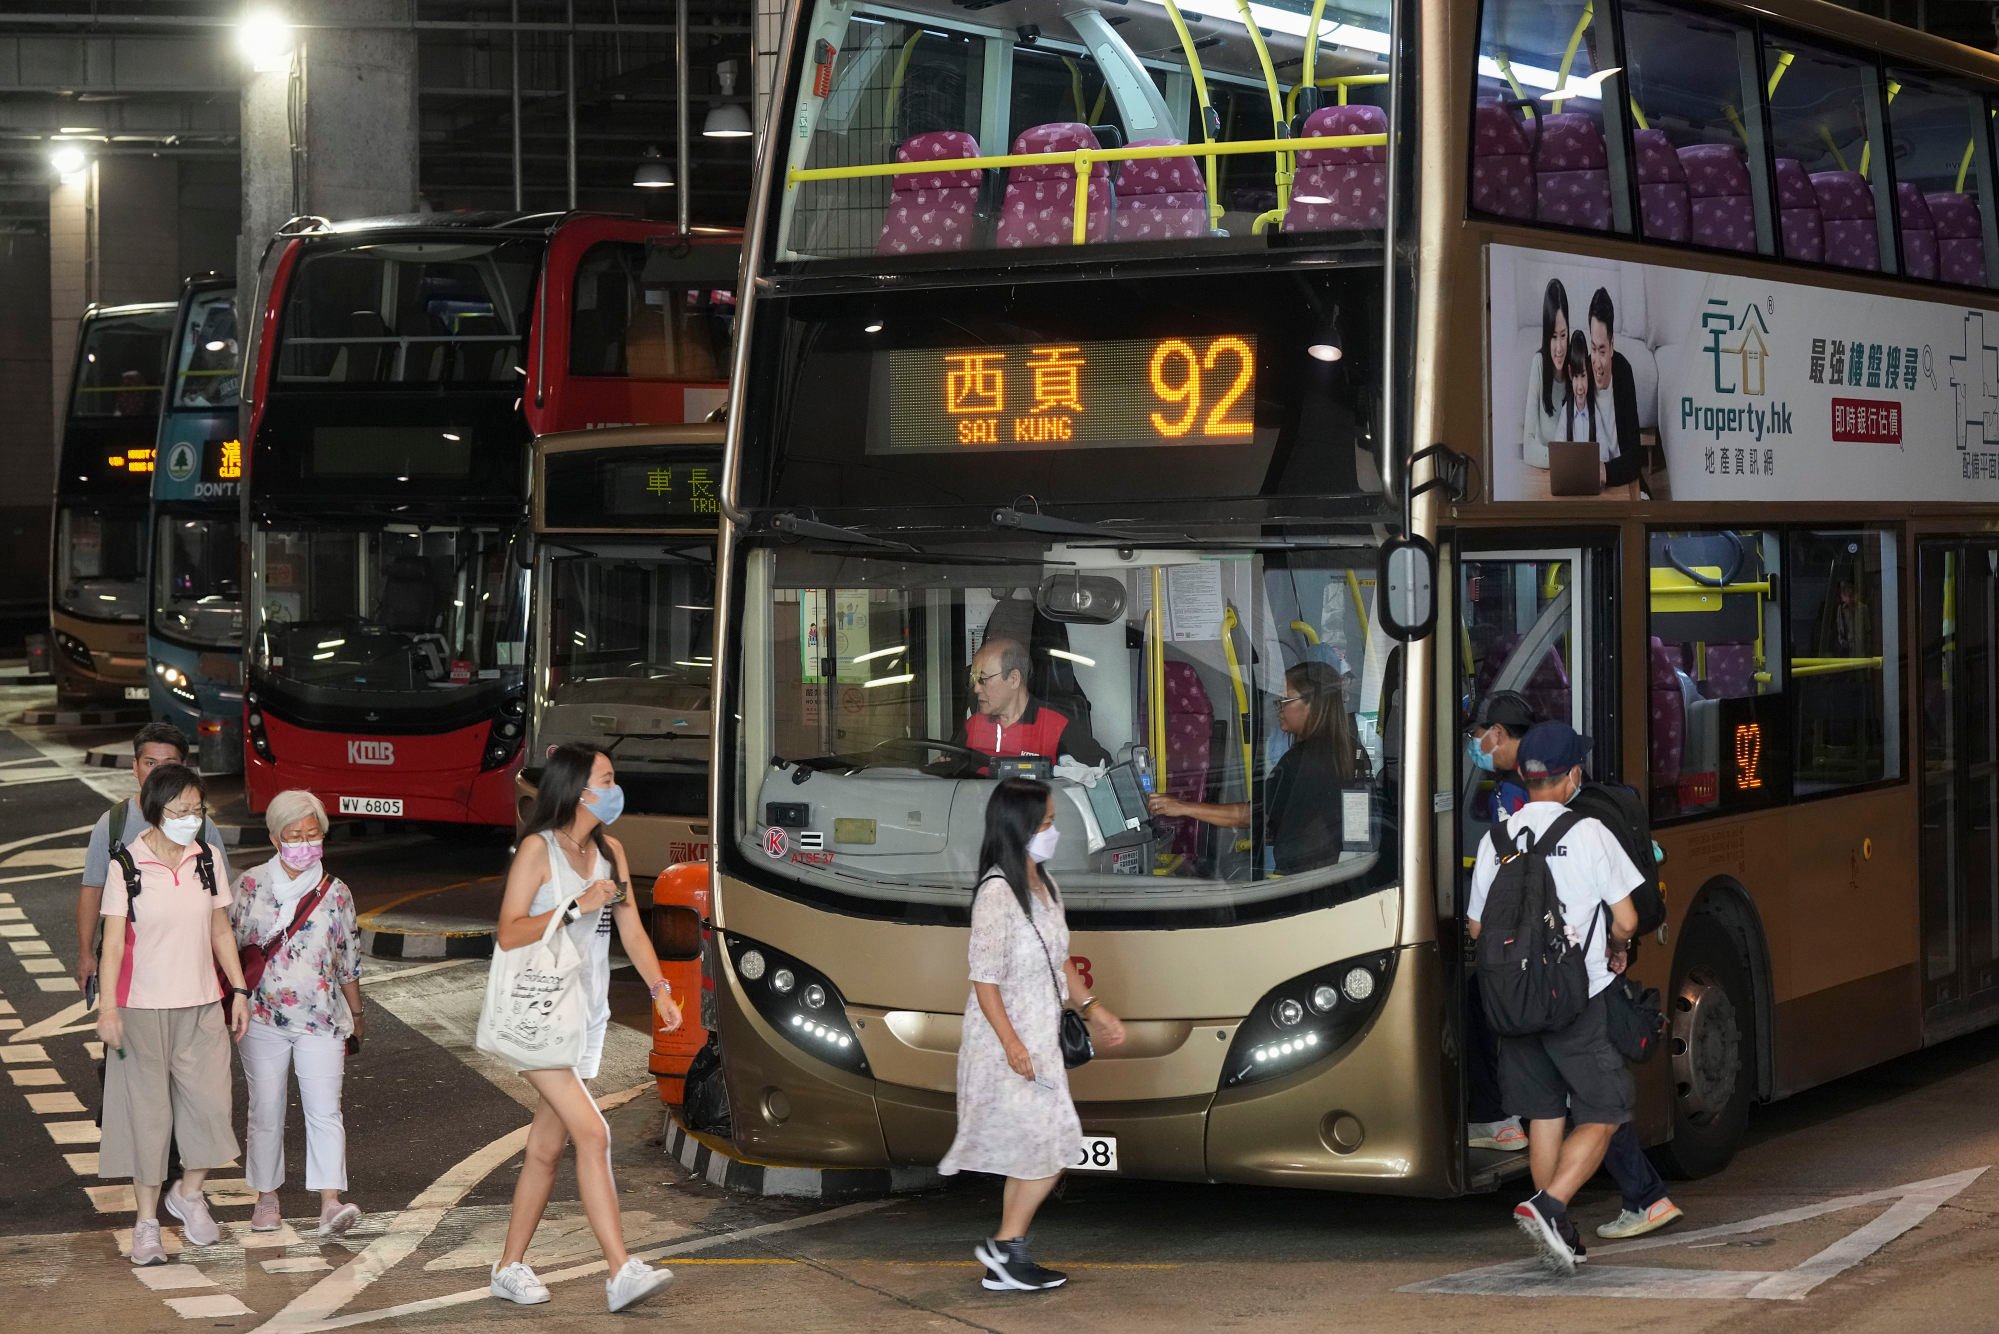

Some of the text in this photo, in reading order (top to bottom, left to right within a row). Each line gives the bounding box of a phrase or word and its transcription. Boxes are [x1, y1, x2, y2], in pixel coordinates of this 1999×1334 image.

[1809, 338, 1919, 391] 最強樓盤搜尋
[944, 346, 1086, 414] 西貢
[1150, 336, 1254, 438] 92
[958, 416, 1072, 444] SAI KUNG
[1681, 397, 1793, 442] Property.hk
[1835, 405, 1899, 436] 即時銀行估價
[1704, 446, 1774, 476] 地產資訊網
[1962, 451, 1999, 481] 配備平面
[194, 482, 234, 497] DON'T
[347, 740, 395, 766] KMB
[1736, 723, 1763, 789] 92
[342, 798, 401, 814] WV 6805
[791, 852, 836, 865] ATSE 37
